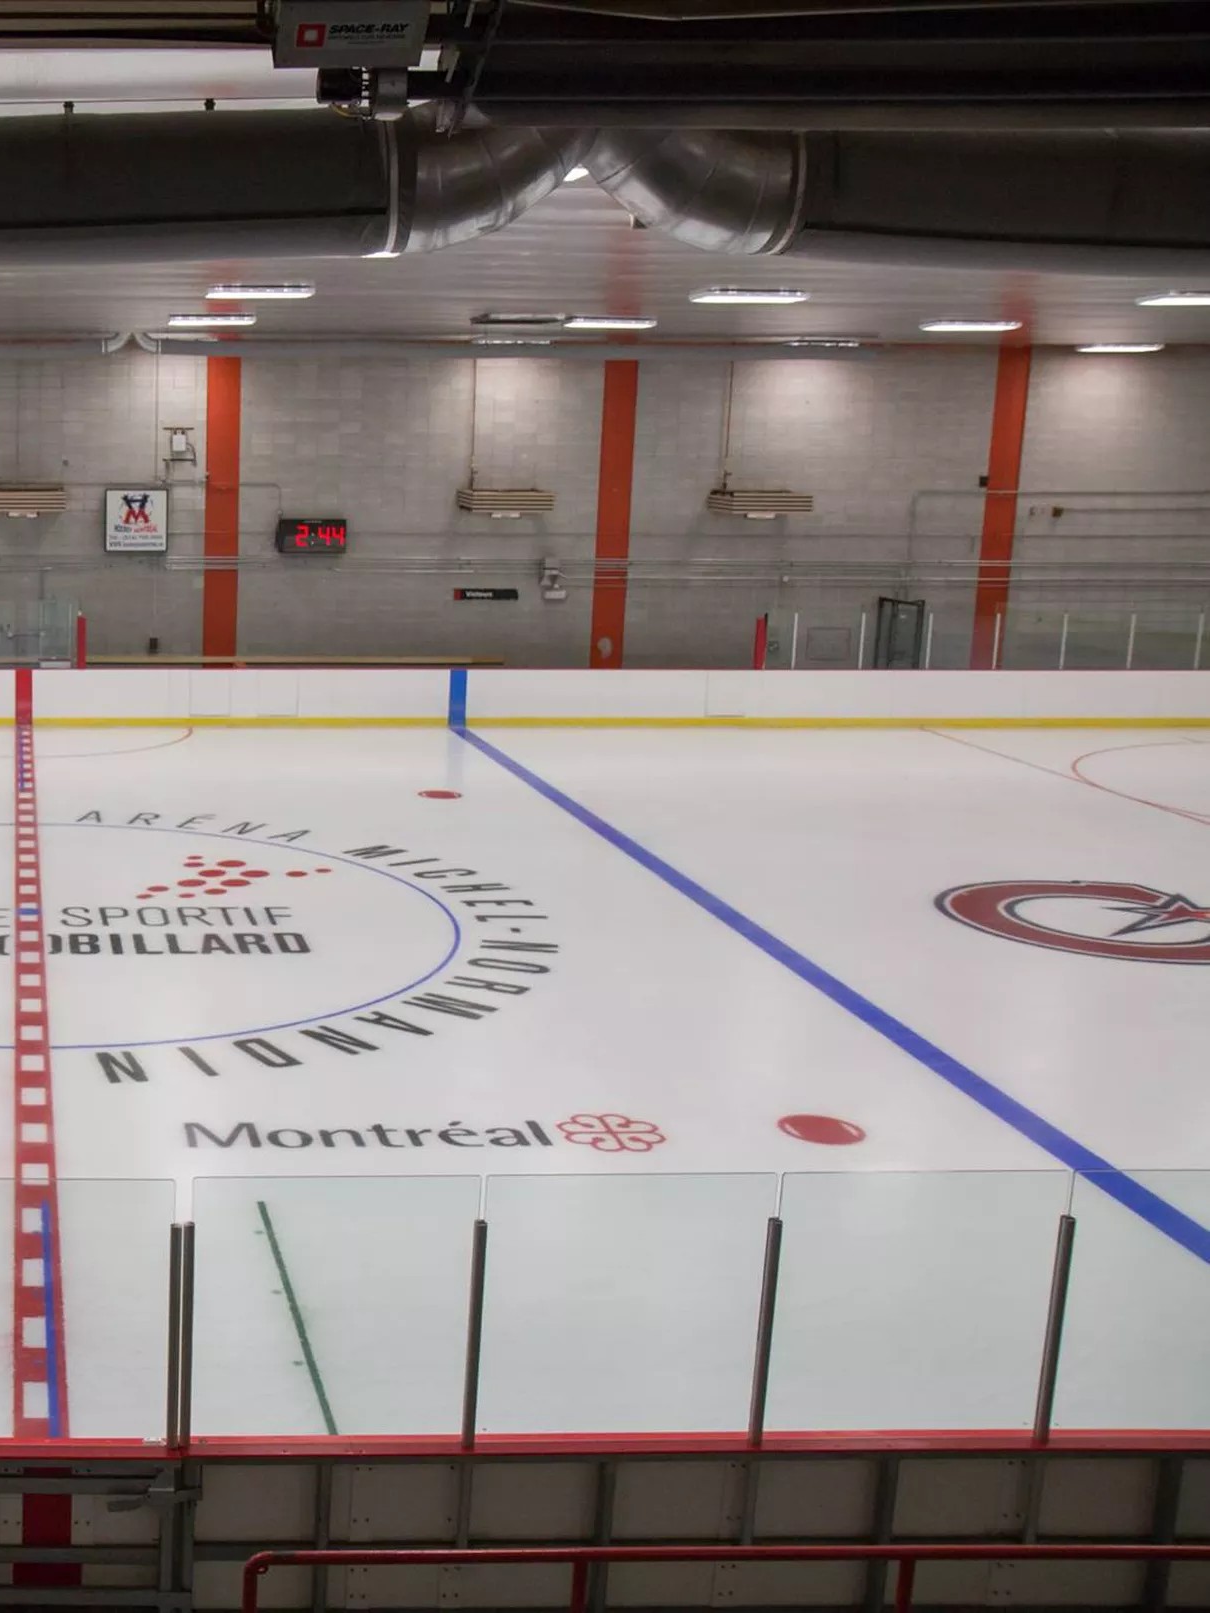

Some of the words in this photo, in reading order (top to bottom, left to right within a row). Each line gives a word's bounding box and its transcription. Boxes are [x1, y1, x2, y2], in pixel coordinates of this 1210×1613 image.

[329, 23, 409, 34] SPACE-RAY
[294, 524, 347, 547] 2:44
[60, 906, 293, 928] SPORTIF
[184, 1119, 553, 1149] Montréal
